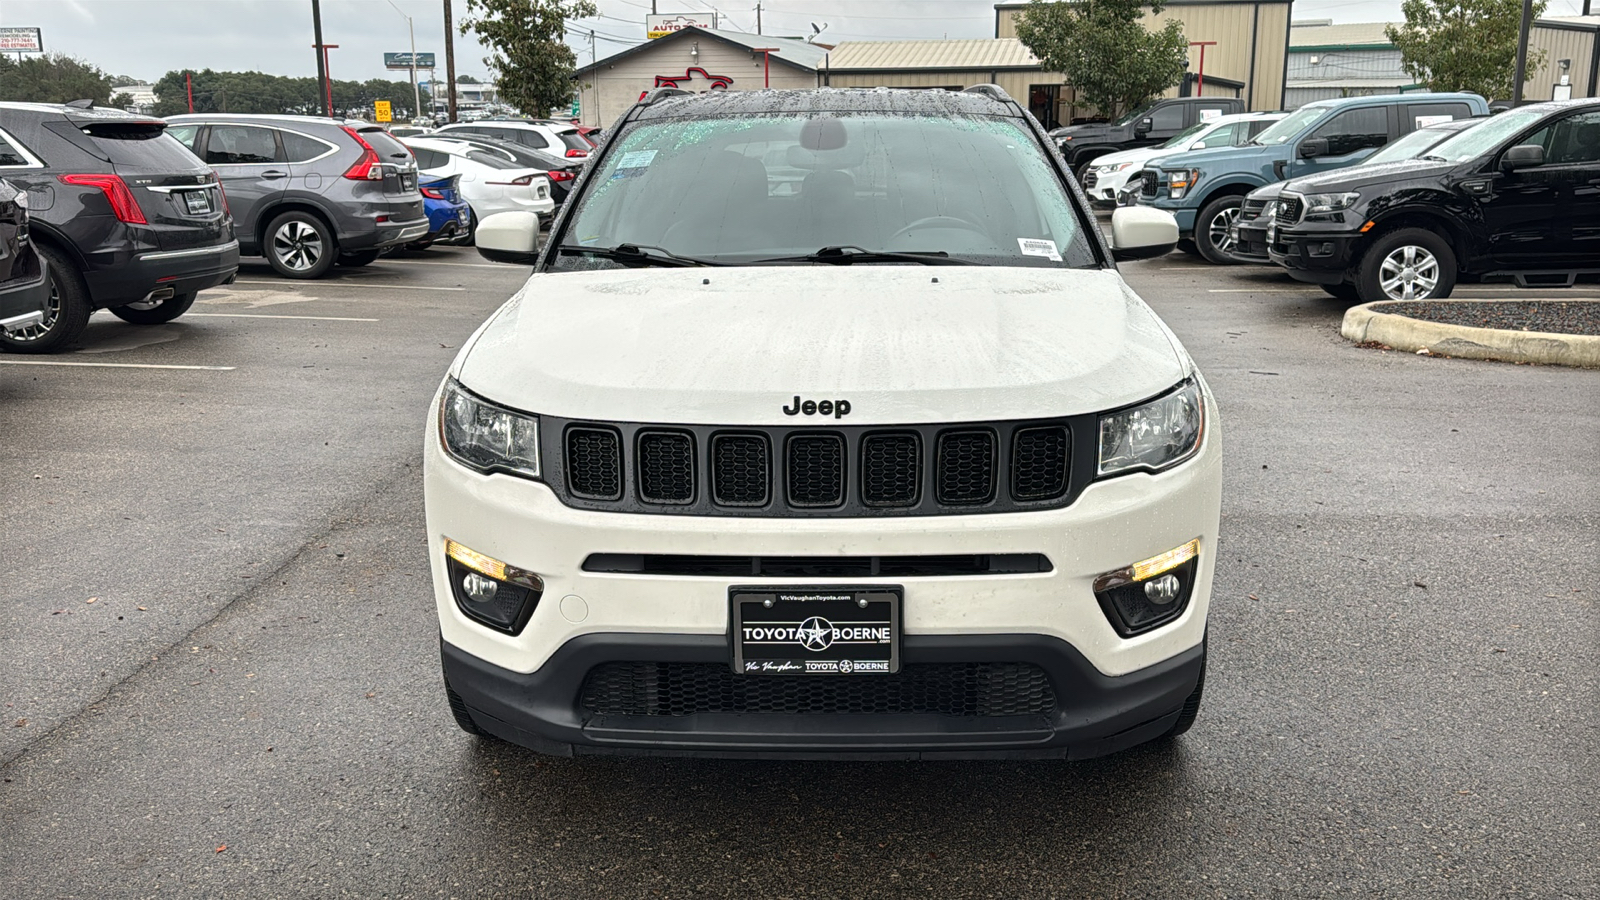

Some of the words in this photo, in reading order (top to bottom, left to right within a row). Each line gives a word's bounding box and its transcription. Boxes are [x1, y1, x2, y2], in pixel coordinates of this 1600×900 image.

[782, 396, 851, 419] Jeep
[743, 628, 806, 640] TOYOTA
[832, 628, 890, 640] BOERNE
[762, 661, 802, 672] Vaughan
